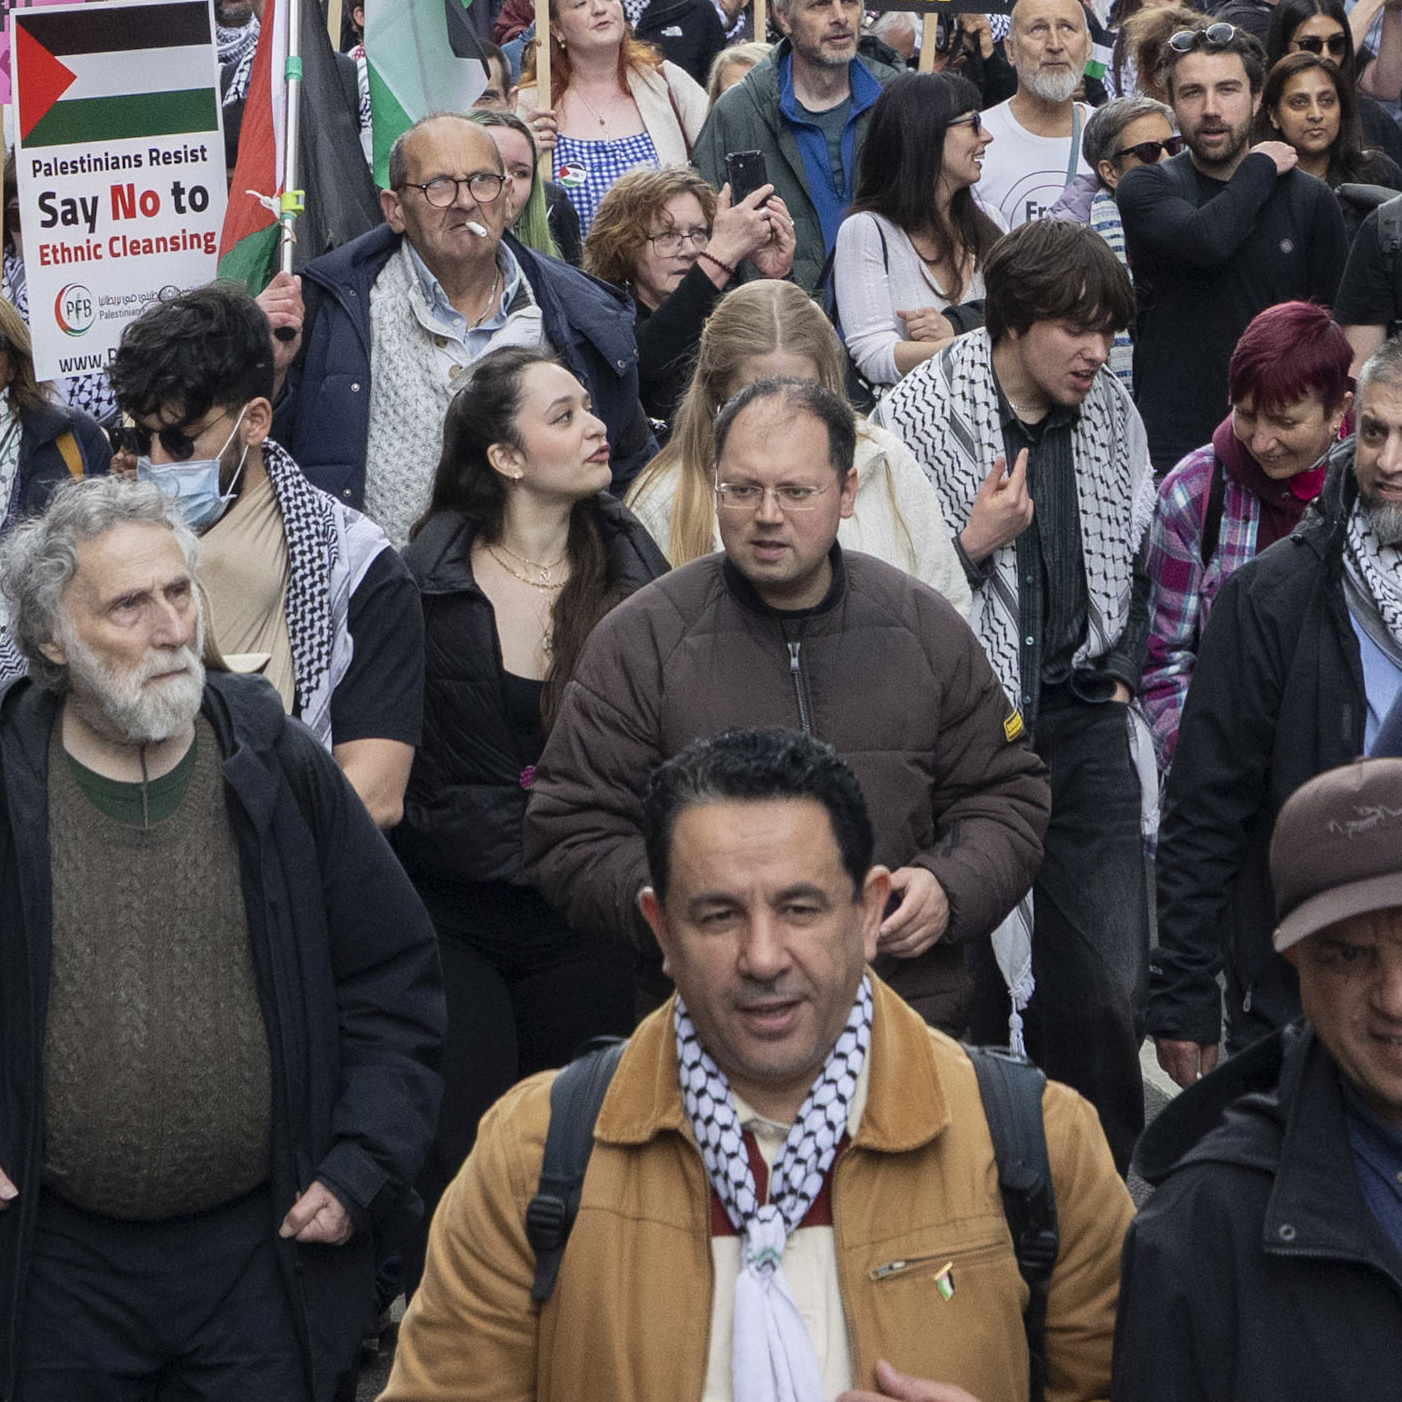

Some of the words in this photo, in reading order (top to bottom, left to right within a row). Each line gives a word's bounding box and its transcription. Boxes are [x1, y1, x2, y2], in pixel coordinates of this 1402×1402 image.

[32, 152, 143, 178] Palestinians
[148, 145, 207, 167] Resist
[38, 191, 98, 234] Say
[110, 183, 160, 221] No
[171, 181, 209, 214] to
[39, 239, 103, 266] Ethnic
[108, 229, 218, 258] Cleansing
[66, 298, 92, 320] PFB
